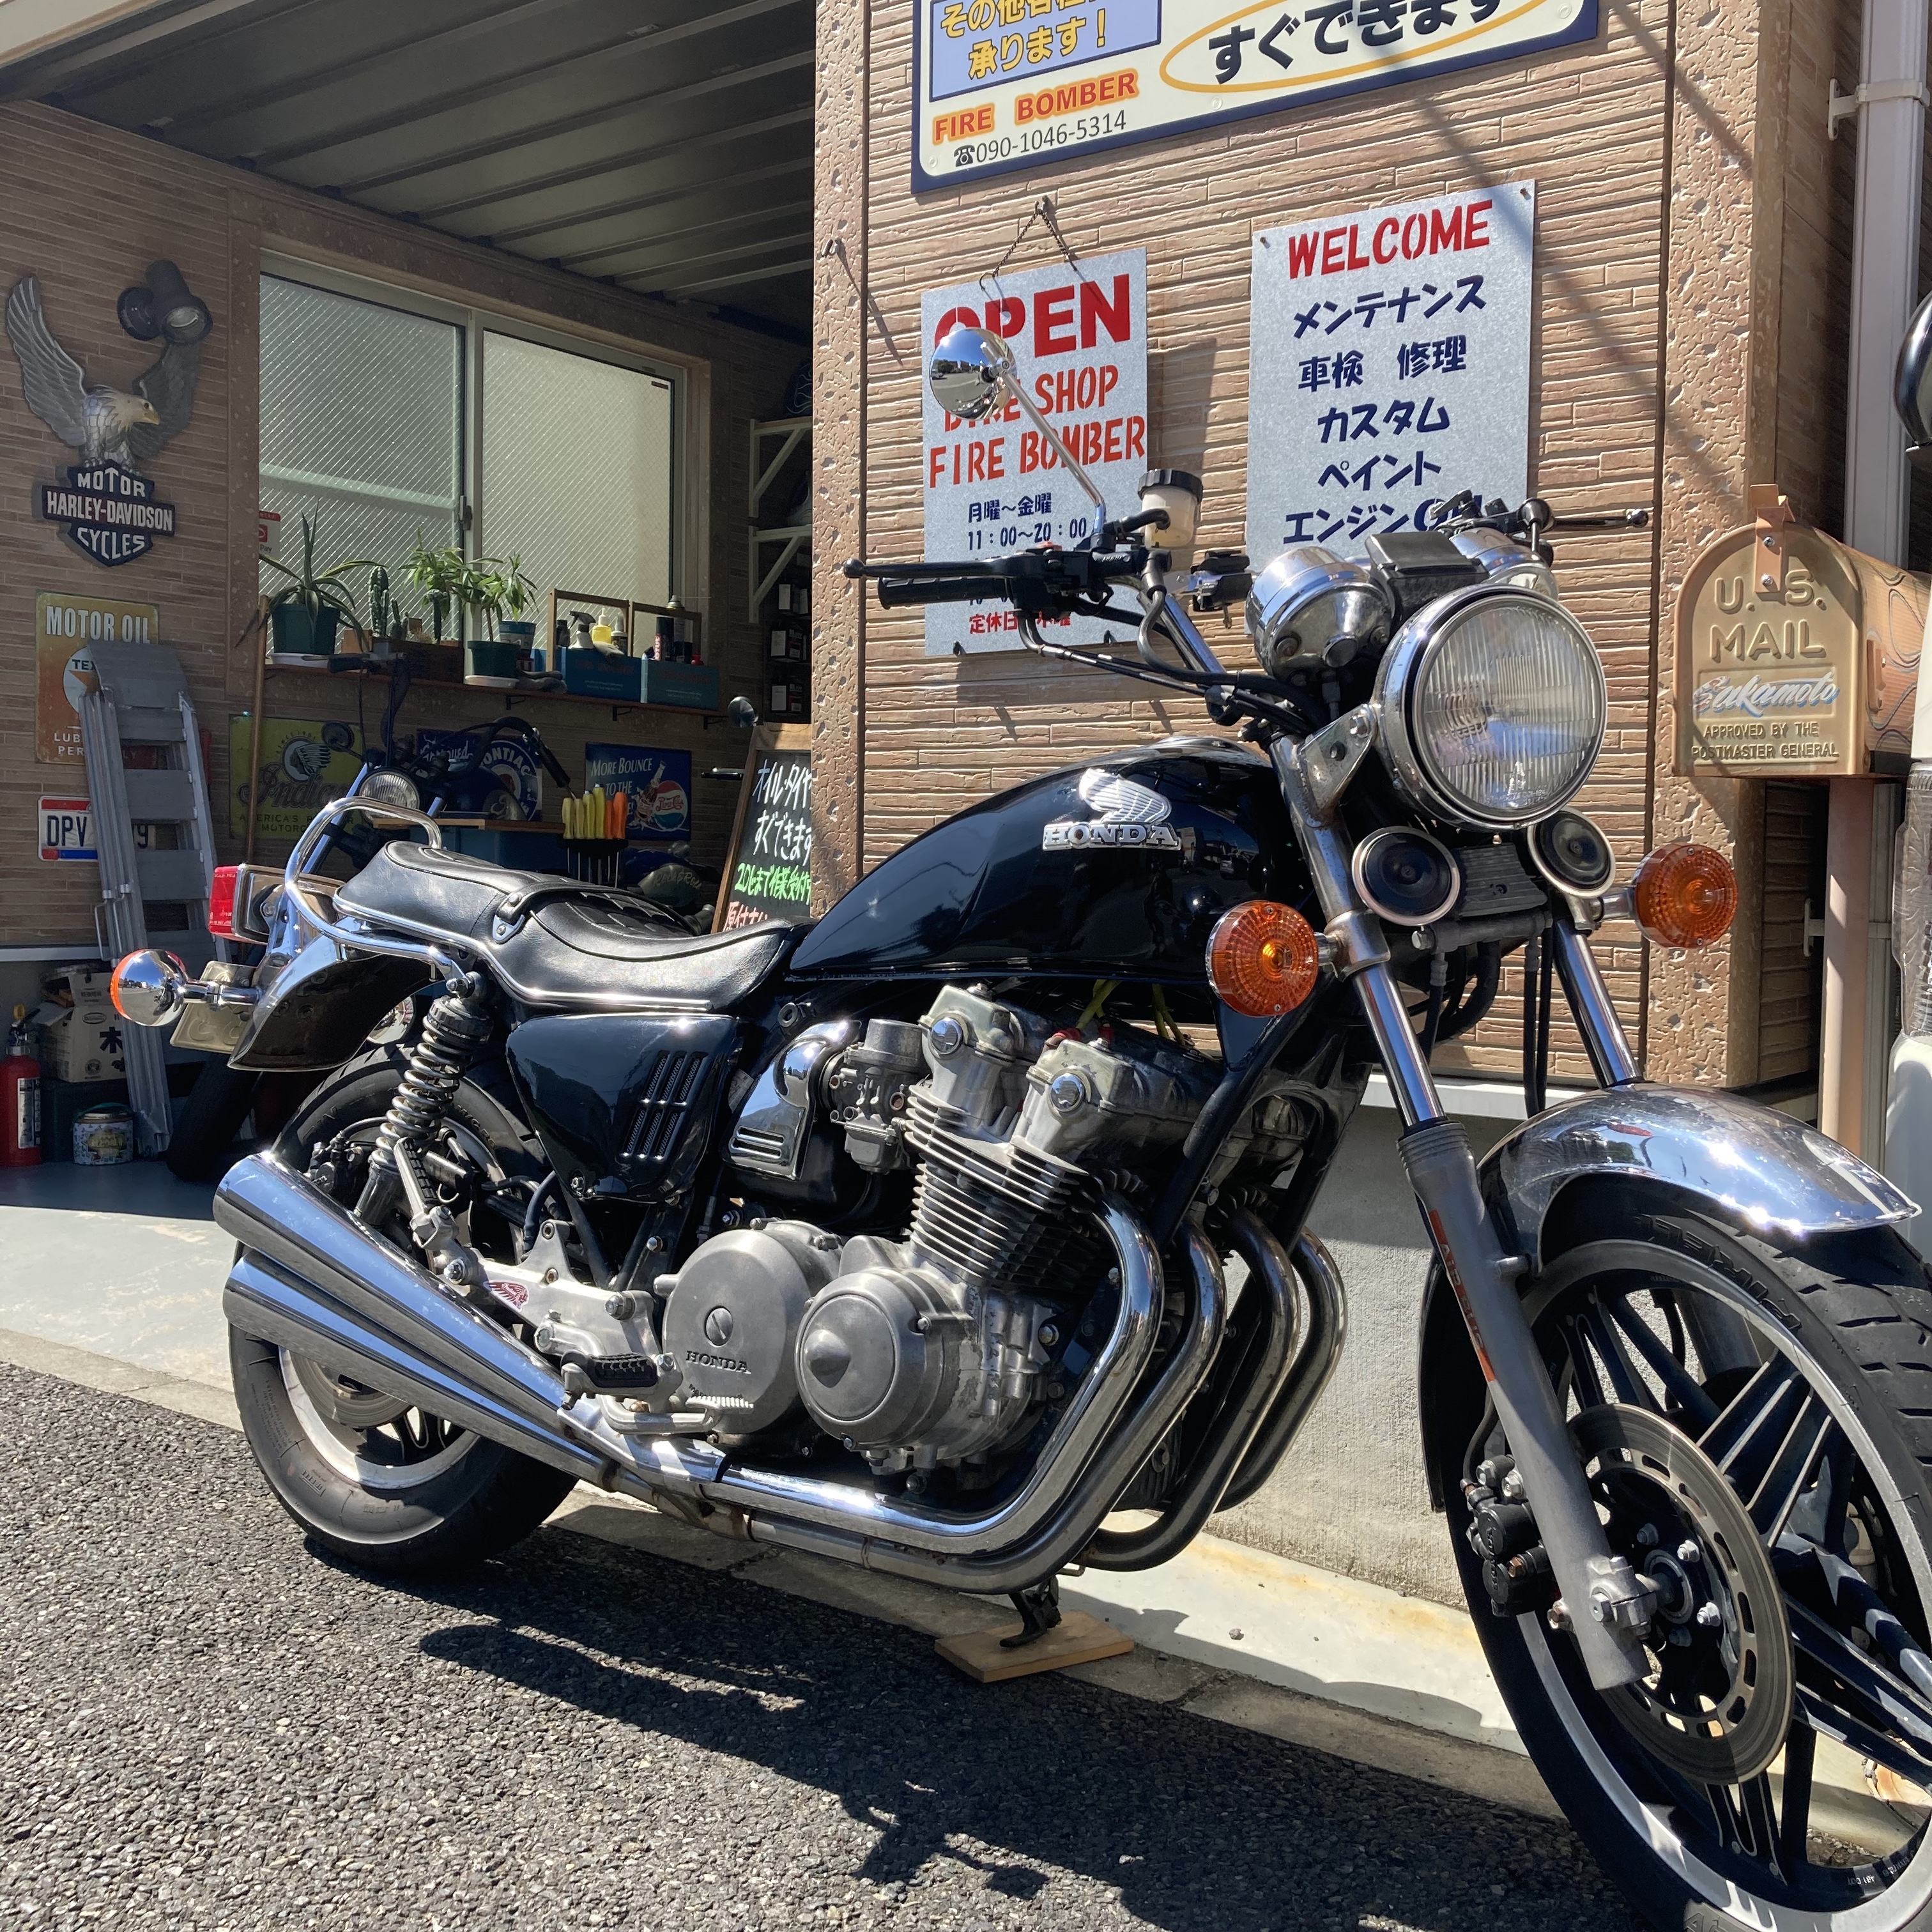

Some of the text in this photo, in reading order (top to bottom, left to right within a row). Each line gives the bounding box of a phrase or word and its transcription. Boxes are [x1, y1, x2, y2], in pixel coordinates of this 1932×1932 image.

[968, 8, 1106, 80] 承ります！
[934, 72, 1137, 142] FIRE BOMBER
[976, 110, 1126, 164] 090-1046-5314
[1289, 199, 1492, 280] WELCOME
[1293, 274, 1487, 339] メンテナンス
[1298, 334, 1468, 392] 車検 修理
[1035, 364, 1119, 416] SHOP
[1317, 396, 1450, 443] カスタム
[930, 415, 1146, 488] FIRE BOMBER
[1317, 450, 1442, 491] ペイント
[77, 467, 146, 497] MOTOR
[47, 491, 172, 531] HARLEY-DAVIDSON
[77, 527, 145, 560] CYCLES
[46, 606, 150, 643] MOTOR OIL
[1710, 618, 1827, 664] MAIL
[1703, 722, 1820, 739] APPROVED BY THE
[482, 746, 531, 776] ONTIAC
[590, 757, 653, 777] MORE BOUNCE
[1692, 742, 1839, 760] POSTMASTER GENERAL
[606, 781, 633, 797] TO THE
[47, 815, 88, 847] DPV
[240, 813, 298, 824] AERICA'S
[1043, 823, 1181, 850] HONDA
[686, 1350, 752, 1374] HONDA
